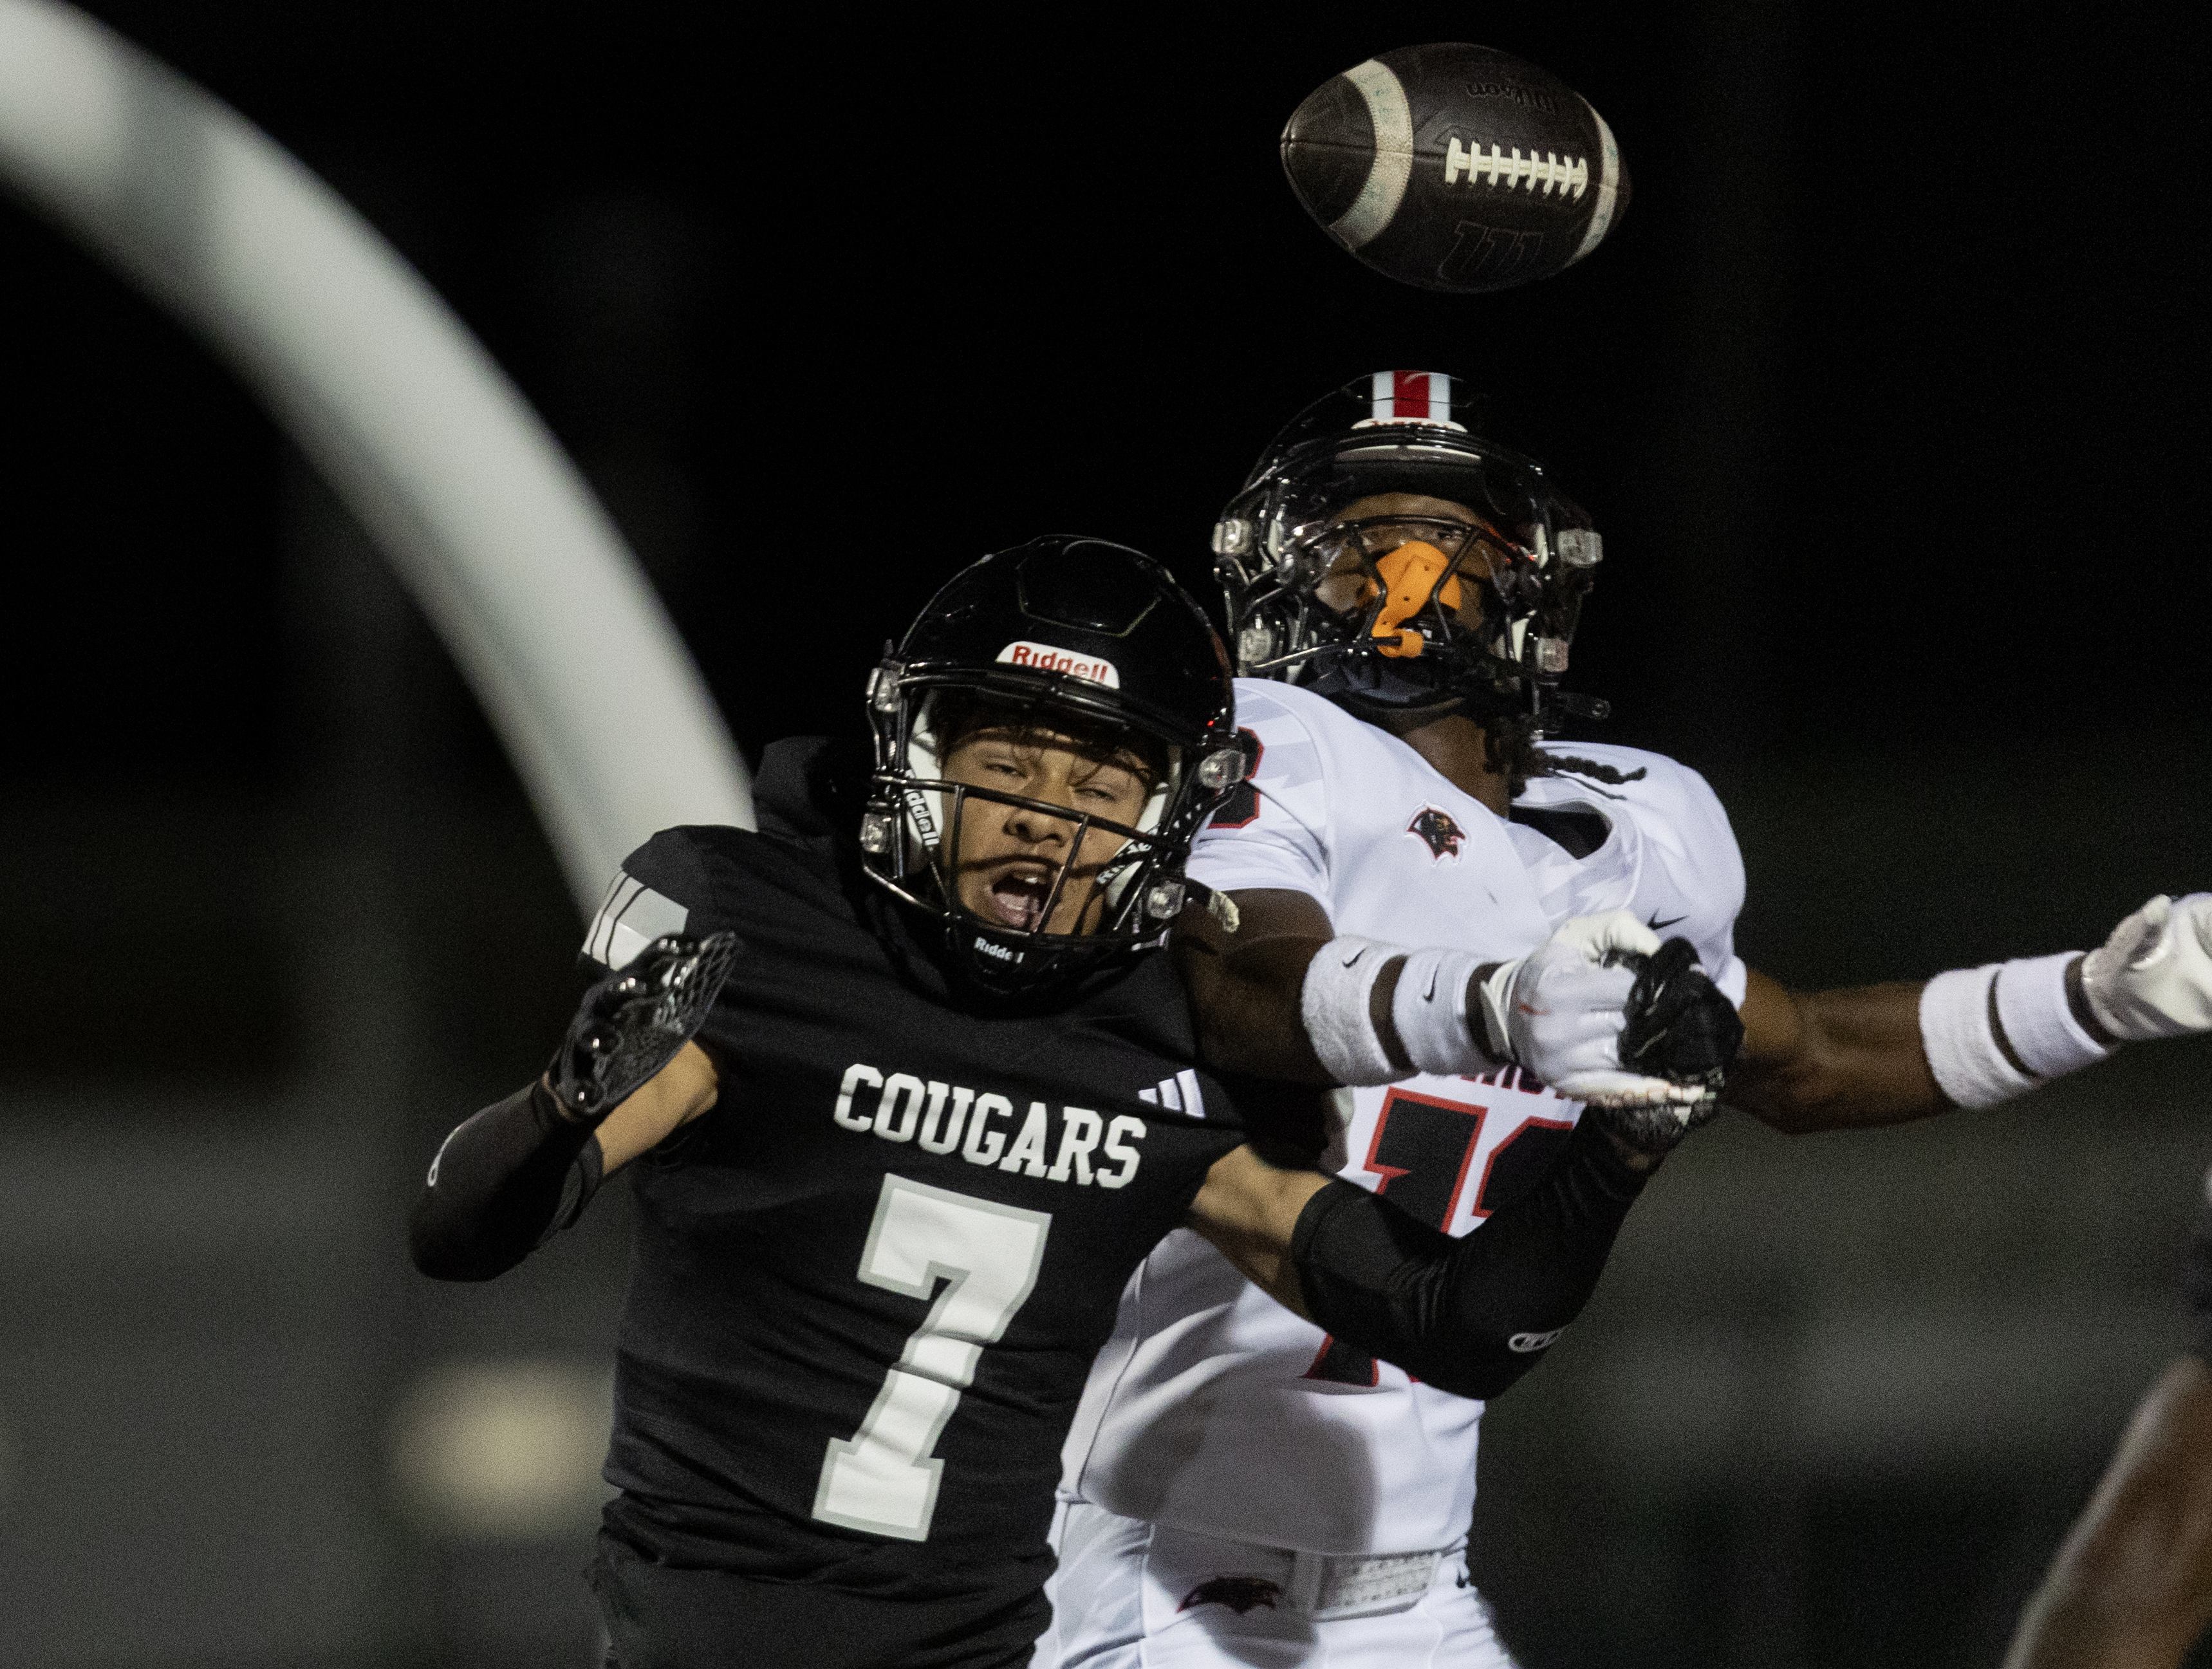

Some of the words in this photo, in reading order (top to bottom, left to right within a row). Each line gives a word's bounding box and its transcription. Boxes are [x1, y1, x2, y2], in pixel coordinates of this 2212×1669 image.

[1012, 645, 1108, 683] Riddell
[974, 937, 1025, 964] Riddel
[834, 1063, 1147, 1189] COUGARS
[812, 1172, 1053, 1542] 7
